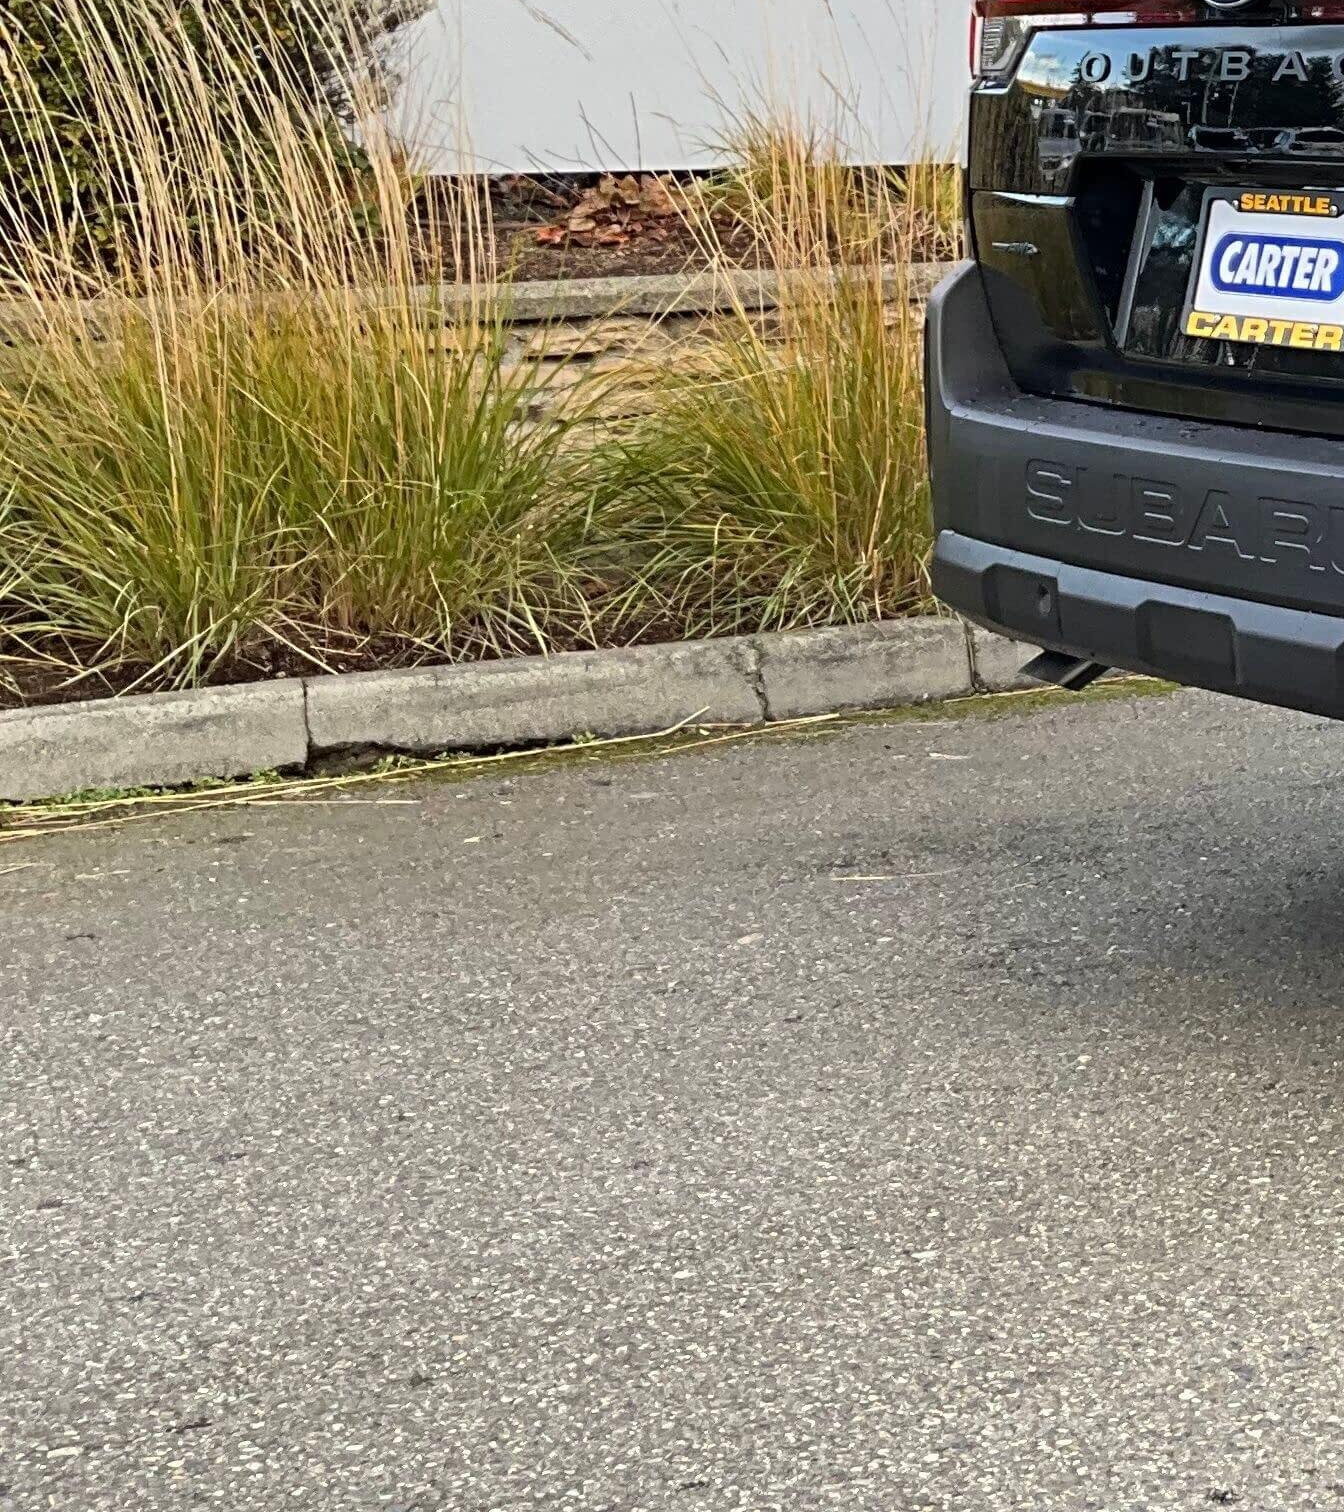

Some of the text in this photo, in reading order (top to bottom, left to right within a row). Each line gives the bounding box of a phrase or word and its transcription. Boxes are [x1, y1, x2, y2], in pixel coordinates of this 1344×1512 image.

[1240, 193, 1331, 215] SEATTLE
[1218, 240, 1340, 293] CARTER
[1186, 311, 1344, 352] CARTER
